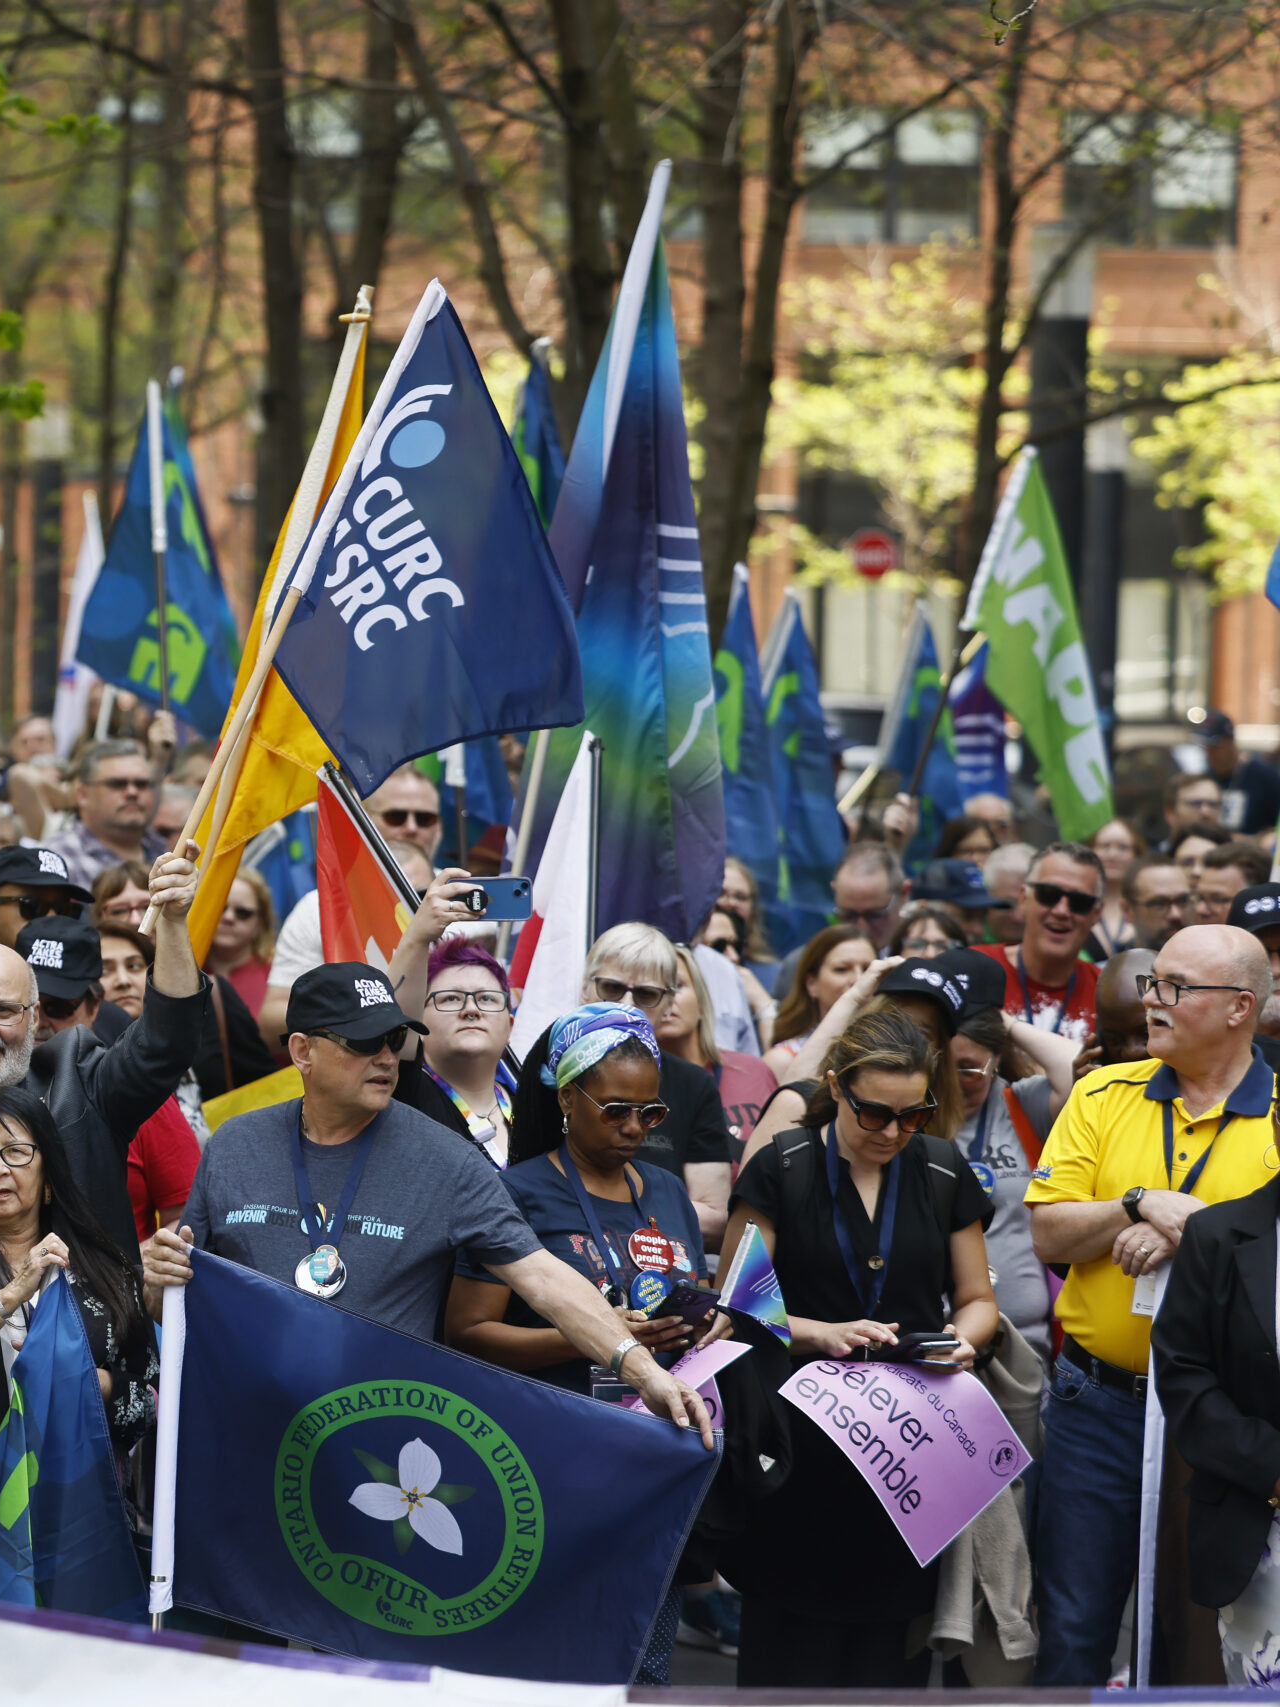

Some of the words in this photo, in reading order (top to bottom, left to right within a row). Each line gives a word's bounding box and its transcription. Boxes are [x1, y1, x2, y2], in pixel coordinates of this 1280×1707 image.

[353, 476, 464, 621] CURC
[324, 518, 408, 651] SRC
[31, 939, 64, 951] ACTRA
[32, 948, 62, 959] TAKES
[27, 955, 63, 969] ACTION
[355, 979, 384, 990] ACTRA
[357, 986, 387, 998] TAKES
[360, 994, 394, 1008] ACTION
[243, 1204, 271, 1212] ENSEMBLE
[271, 1206, 289, 1214] POUR
[634, 1233, 667, 1246] people
[641, 1246, 663, 1254] over
[636, 1253, 668, 1266] profits
[637, 1282, 663, 1298] whining
[640, 1277, 654, 1288] stop
[645, 1290, 661, 1302] start
[869, 1361, 928, 1395] yndicats
[927, 1392, 946, 1412] du
[942, 1409, 977, 1458] Canada
[290, 1387, 451, 1450] FEDERATION
[456, 1409, 493, 1440] OF
[795, 1377, 921, 1515] ensemble
[490, 1442, 536, 1538] UNION
[282, 1454, 333, 1582] ONTARIO
[340, 1559, 428, 1614] OFUR
[433, 1544, 535, 1628] RETIREES
[384, 1612, 414, 1630] CURC
